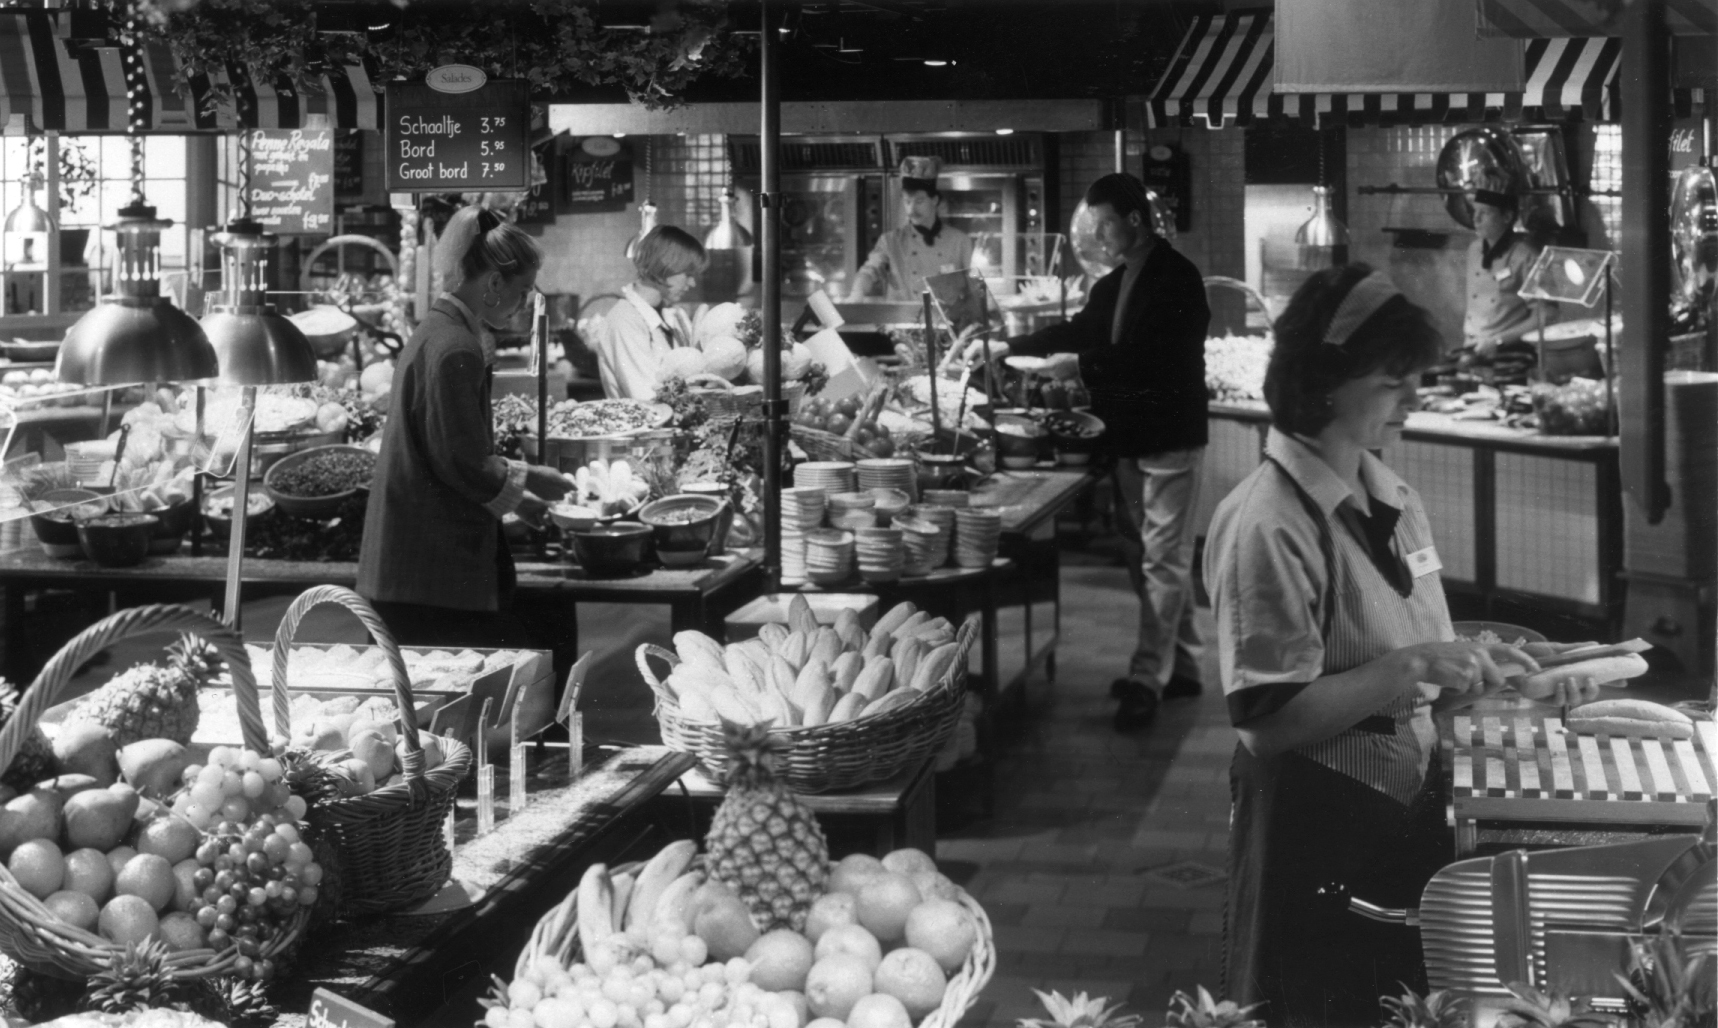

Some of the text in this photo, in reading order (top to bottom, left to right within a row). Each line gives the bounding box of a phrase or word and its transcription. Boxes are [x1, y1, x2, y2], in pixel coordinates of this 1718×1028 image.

[441, 73, 472, 83] Salades
[400, 115, 505, 138] Schaaltje 3.75
[400, 140, 505, 158] Bord 5.95
[1668, 128, 1694, 160] filet
[399, 161, 505, 180] Groot bord 7.50
